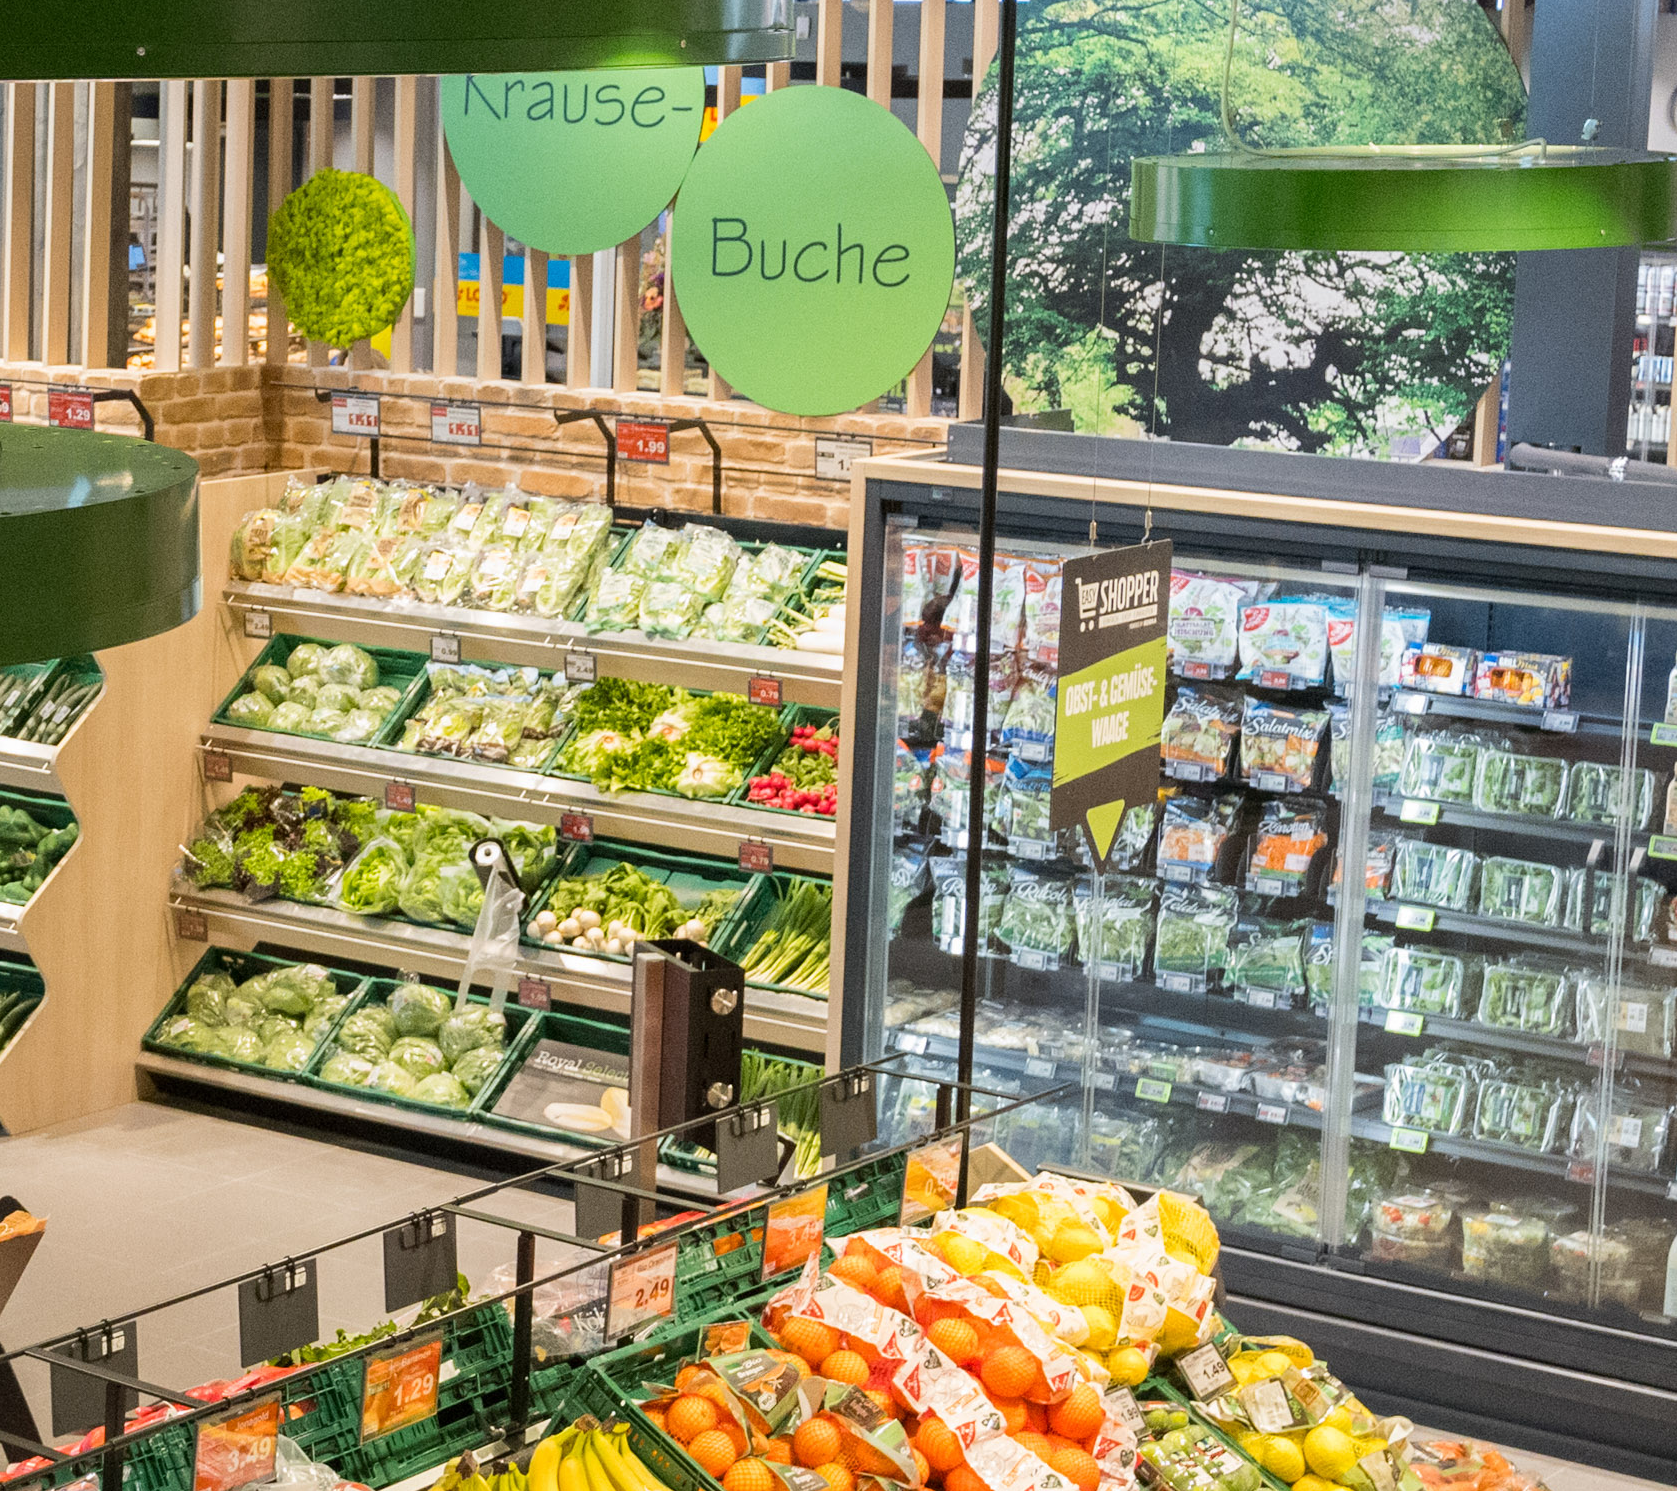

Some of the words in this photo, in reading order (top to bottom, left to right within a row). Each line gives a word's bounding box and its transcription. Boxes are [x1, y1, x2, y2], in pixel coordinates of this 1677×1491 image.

[463, 73, 694, 128] Krause-
[711, 217, 910, 287] Buche
[637, 440, 666, 454] 1.99
[1099, 570, 1159, 614] SHOPPER
[1065, 680, 1097, 717] OBST-
[1099, 678, 1108, 709] &
[1109, 662, 1158, 706] GEMÜSE-
[1091, 711, 1130, 749] WAAGE
[635, 1278, 670, 1308] 2.49
[394, 1372, 434, 1407] 1.29
[226, 1436, 272, 1472] 3.49
